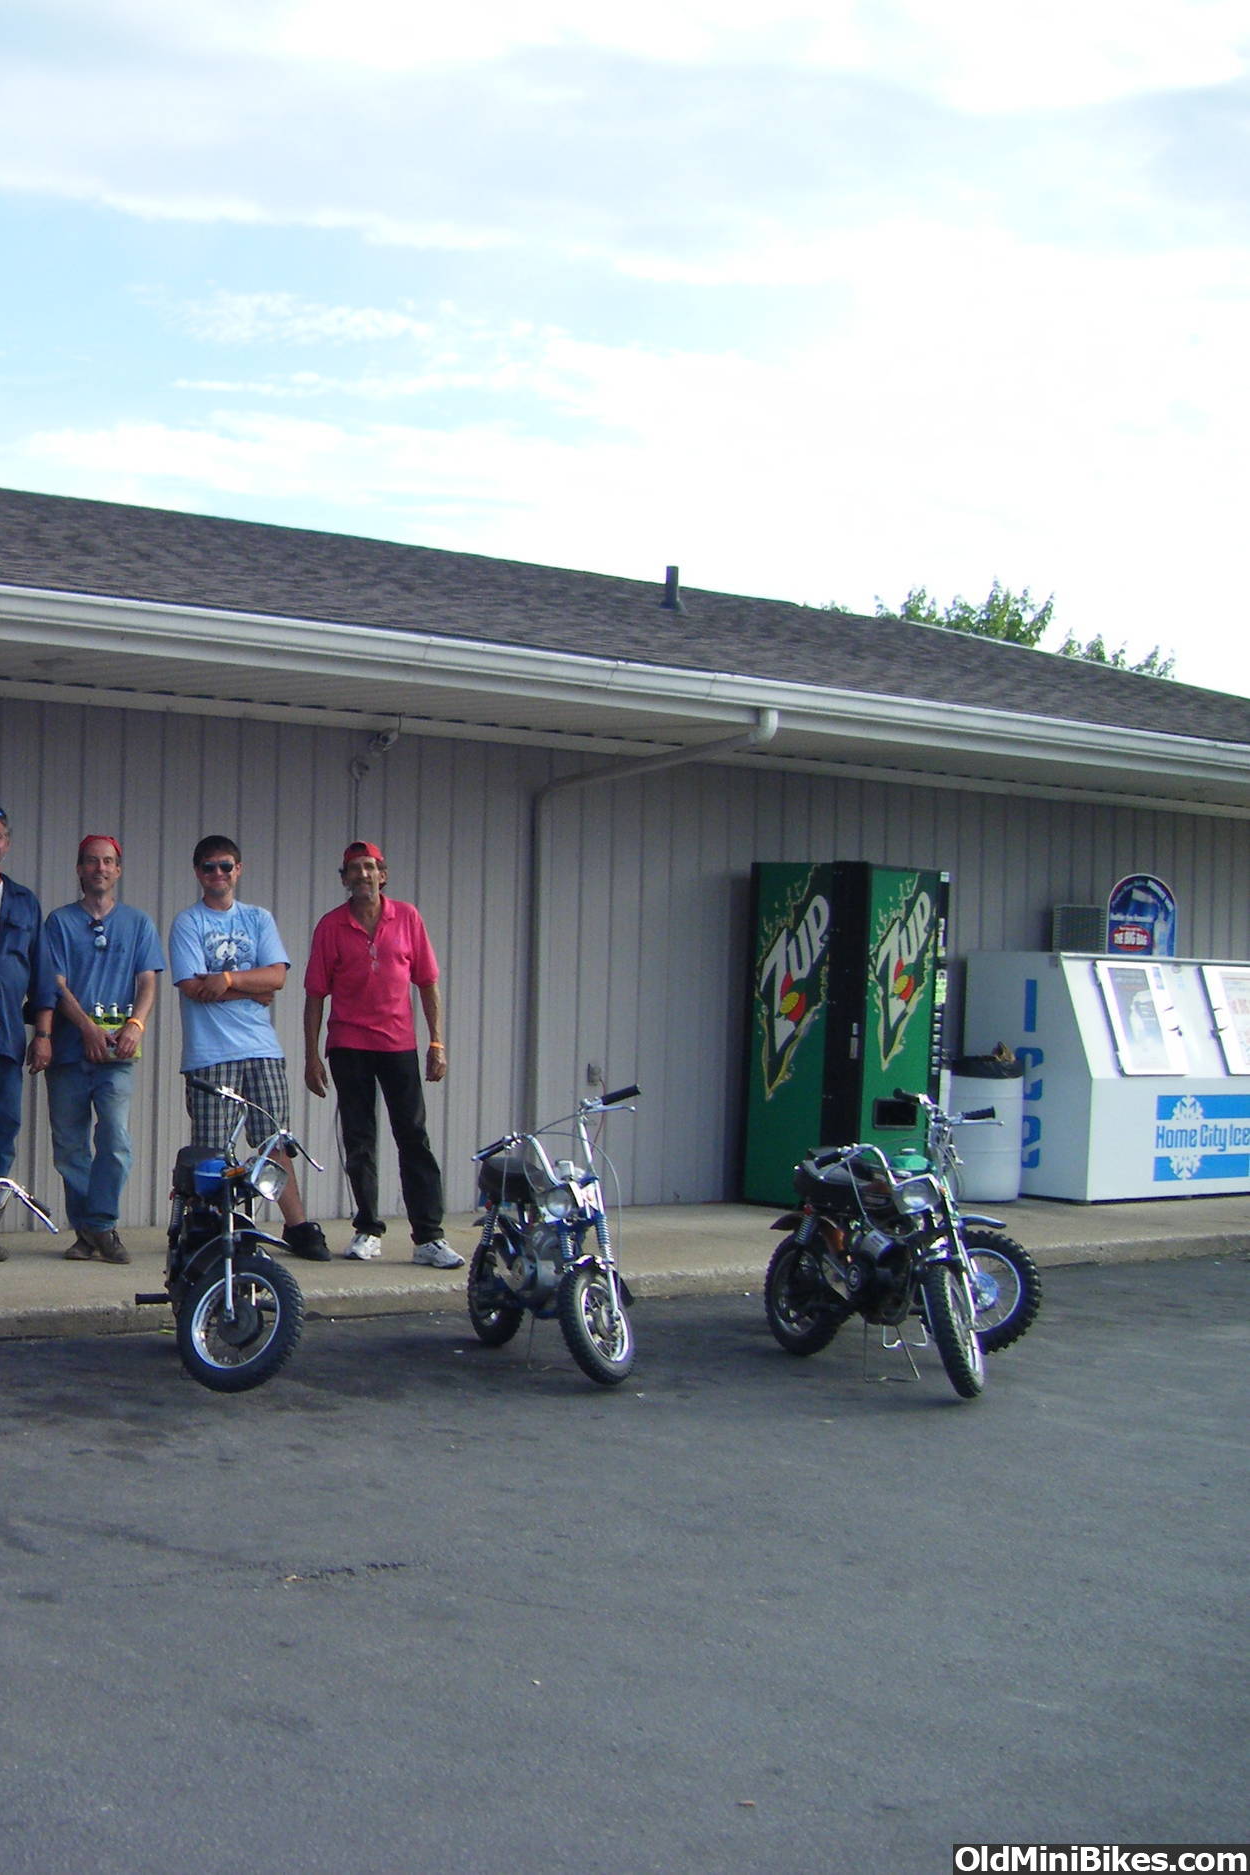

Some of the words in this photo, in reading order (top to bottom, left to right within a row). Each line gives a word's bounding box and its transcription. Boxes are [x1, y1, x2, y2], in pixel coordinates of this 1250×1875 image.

[760, 894, 830, 1054] 7UP
[876, 891, 931, 1030] 7UP
[1156, 1125, 1198, 1149] Home
[1199, 1124, 1227, 1152] City
